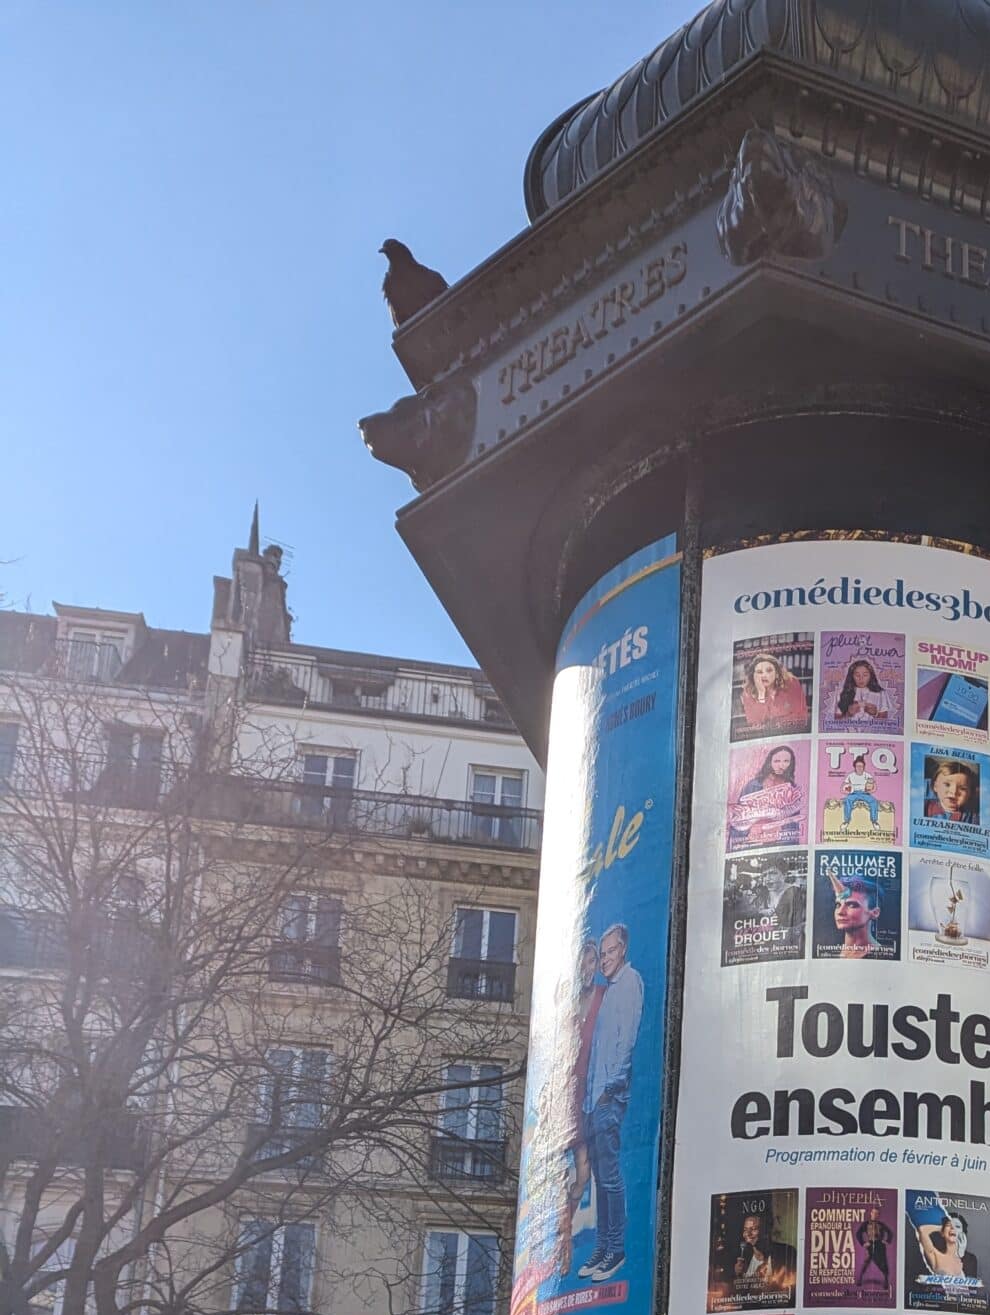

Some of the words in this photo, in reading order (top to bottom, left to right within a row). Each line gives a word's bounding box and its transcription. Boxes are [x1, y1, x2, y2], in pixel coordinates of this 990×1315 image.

[499, 242, 690, 404] THEATRES
[917, 643, 966, 660] SHUT
[967, 650, 989, 663] UP
[930, 655, 977, 672] MOM!
[930, 748, 951, 757] LISA
[951, 751, 976, 761] BLUM
[913, 818, 990, 837] ULTRASENSIBLE
[820, 855, 896, 868] RALLUMER
[920, 857, 946, 868] Arrête
[820, 867, 838, 876] LES
[842, 867, 896, 878] LUCIOLES
[735, 916, 778, 930] CHLOÉ
[735, 930, 788, 945] DROUET
[765, 1148, 875, 1165] Programmation
[880, 1149, 898, 1162] de
[902, 1149, 947, 1167] février
[950, 1153, 960, 1167] à
[961, 1156, 987, 1173] juin
[743, 1200, 765, 1213] NGO
[914, 1196, 988, 1211] ANTONELLA
[811, 1209, 865, 1222] COMMENT
[811, 1231, 855, 1252] DIVA
[810, 1253, 828, 1268] EN
[832, 1253, 855, 1269] SOI
[821, 1276, 855, 1284] INNOCENTS
[926, 1276, 952, 1284] MERCI
